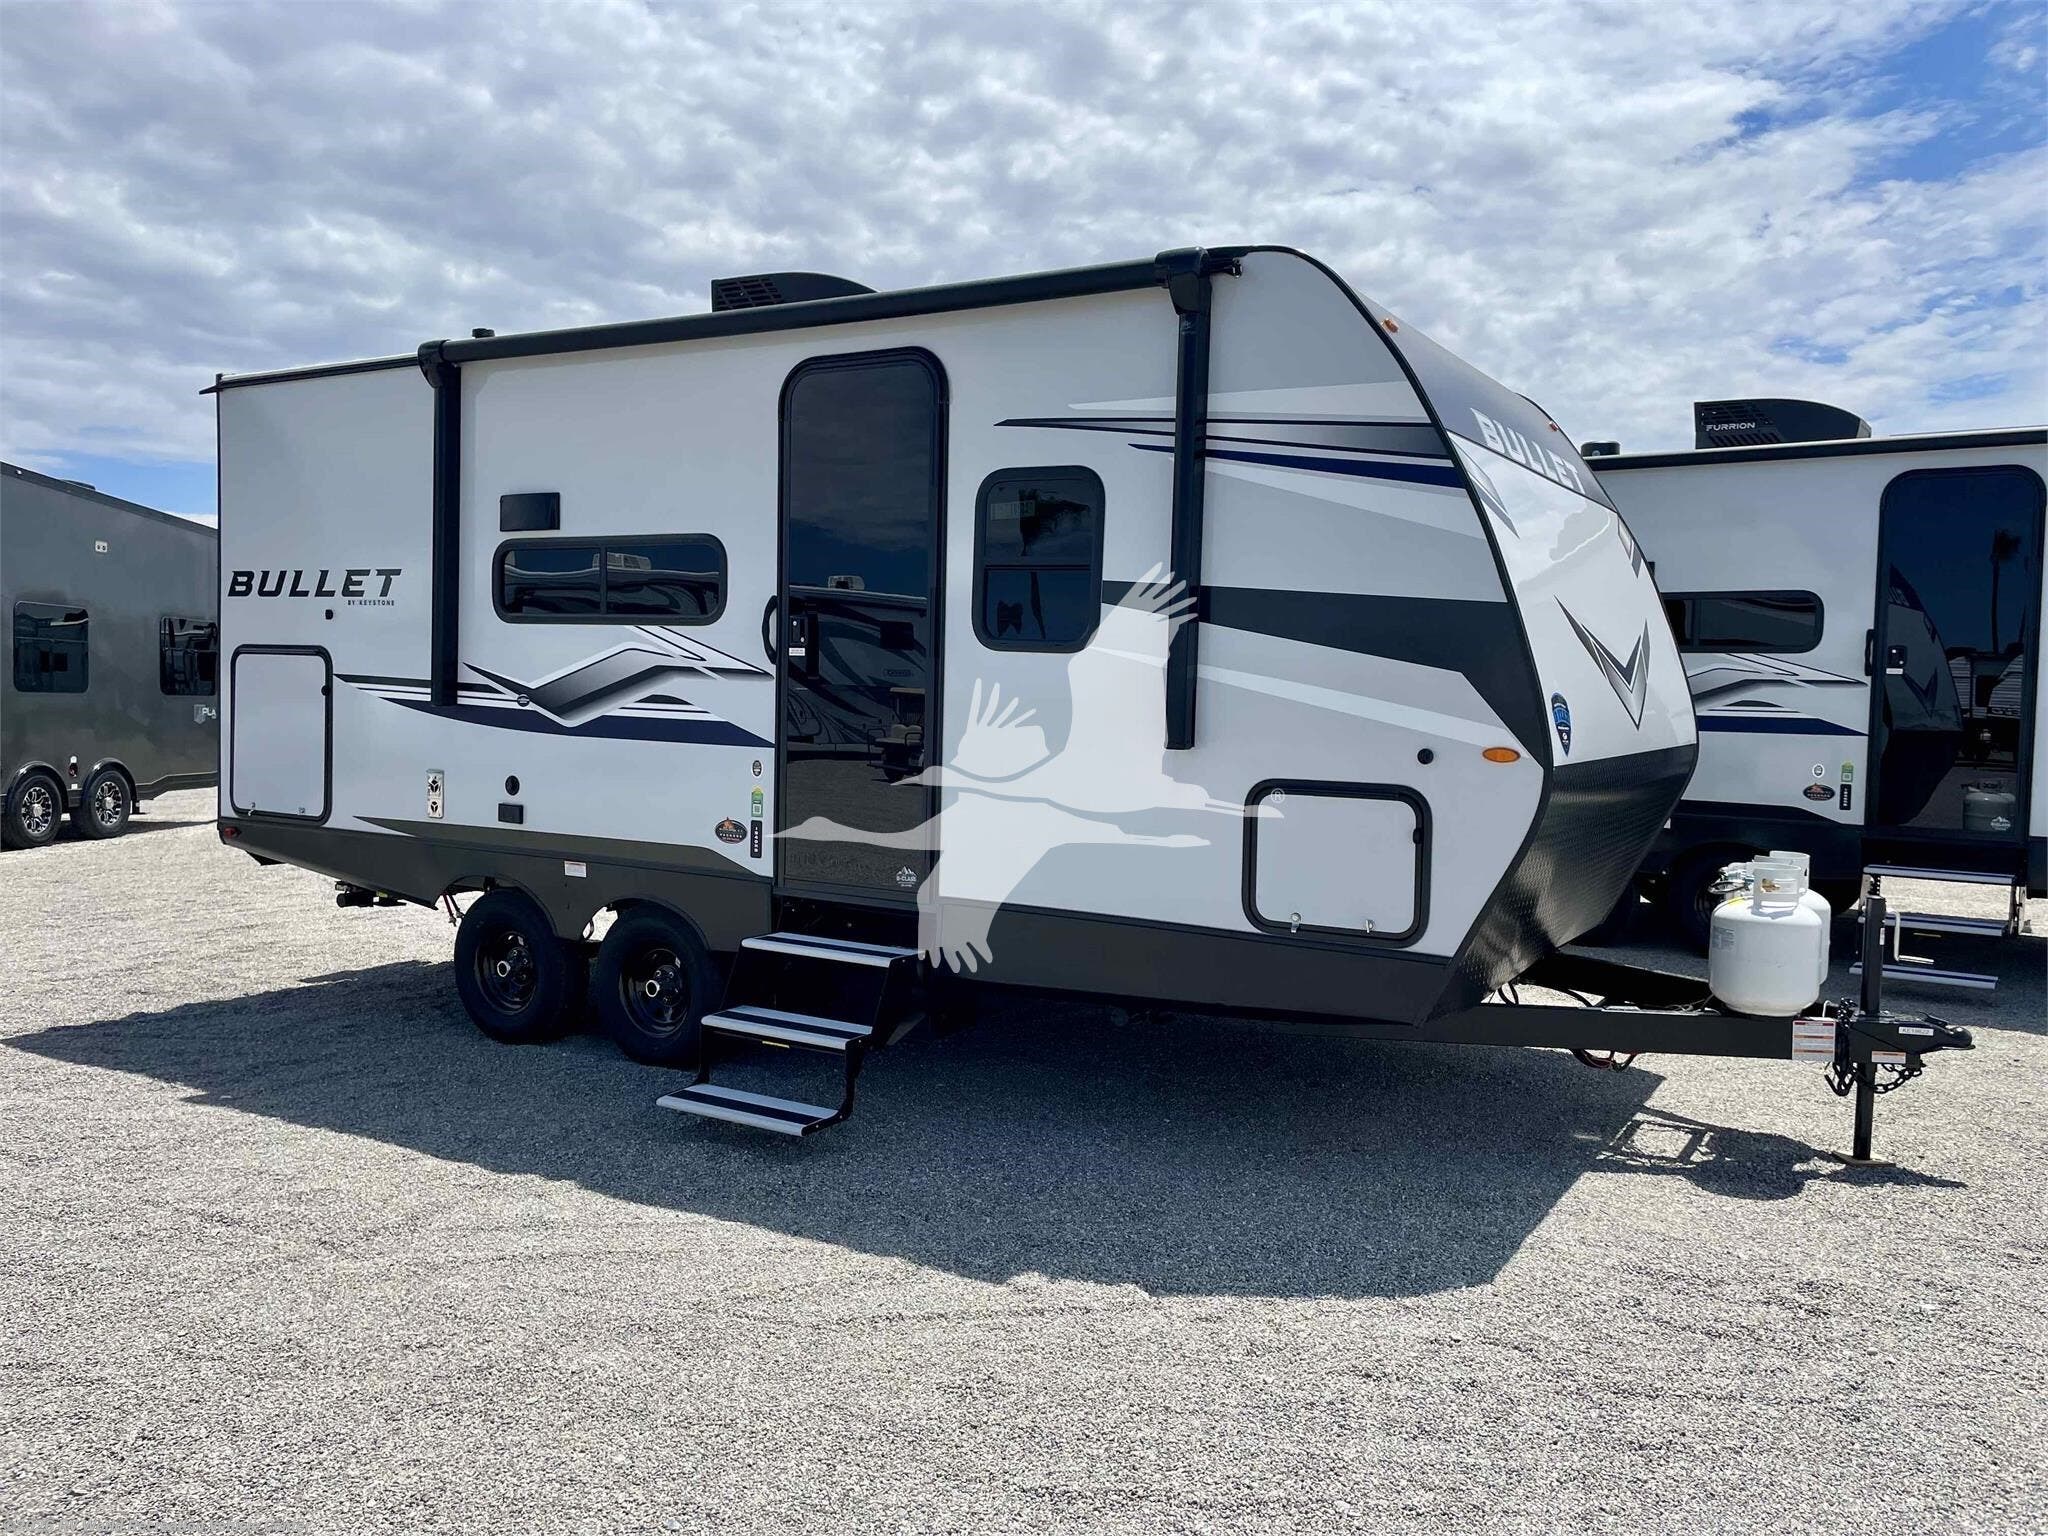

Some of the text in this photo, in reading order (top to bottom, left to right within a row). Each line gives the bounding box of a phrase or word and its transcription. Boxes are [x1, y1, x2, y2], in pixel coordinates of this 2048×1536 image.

[1705, 421, 1756, 432] FURRION
[1470, 407, 1586, 494] BULLET
[227, 568, 402, 598] BULLET
